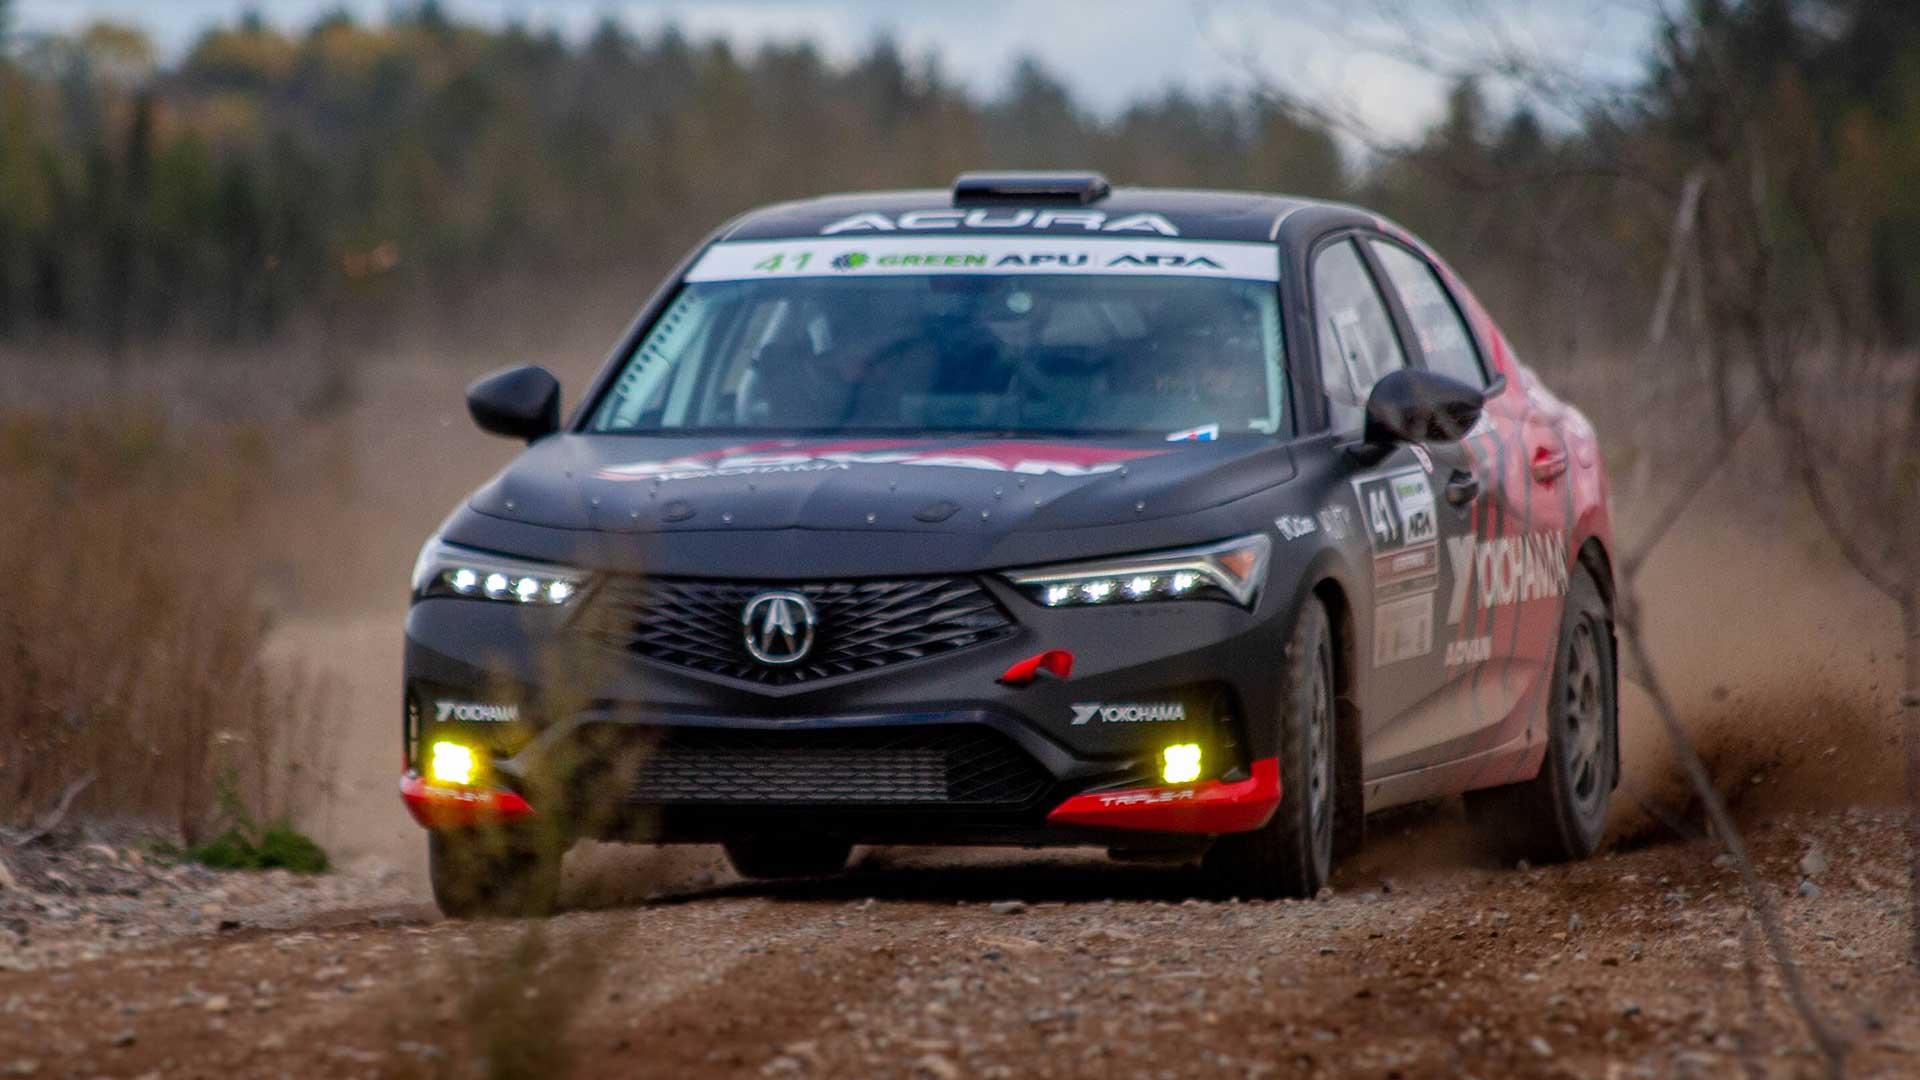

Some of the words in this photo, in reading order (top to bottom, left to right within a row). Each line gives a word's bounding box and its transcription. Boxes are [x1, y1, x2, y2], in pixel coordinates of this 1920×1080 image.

[820, 209, 1179, 237] ACURA
[753, 252, 815, 273] 41
[876, 253, 986, 268] GREEN
[995, 253, 1089, 268] APU
[1106, 254, 1226, 270] ARA
[1368, 488, 1397, 542] 41
[1099, 703, 1187, 722] YOKOHAMA
